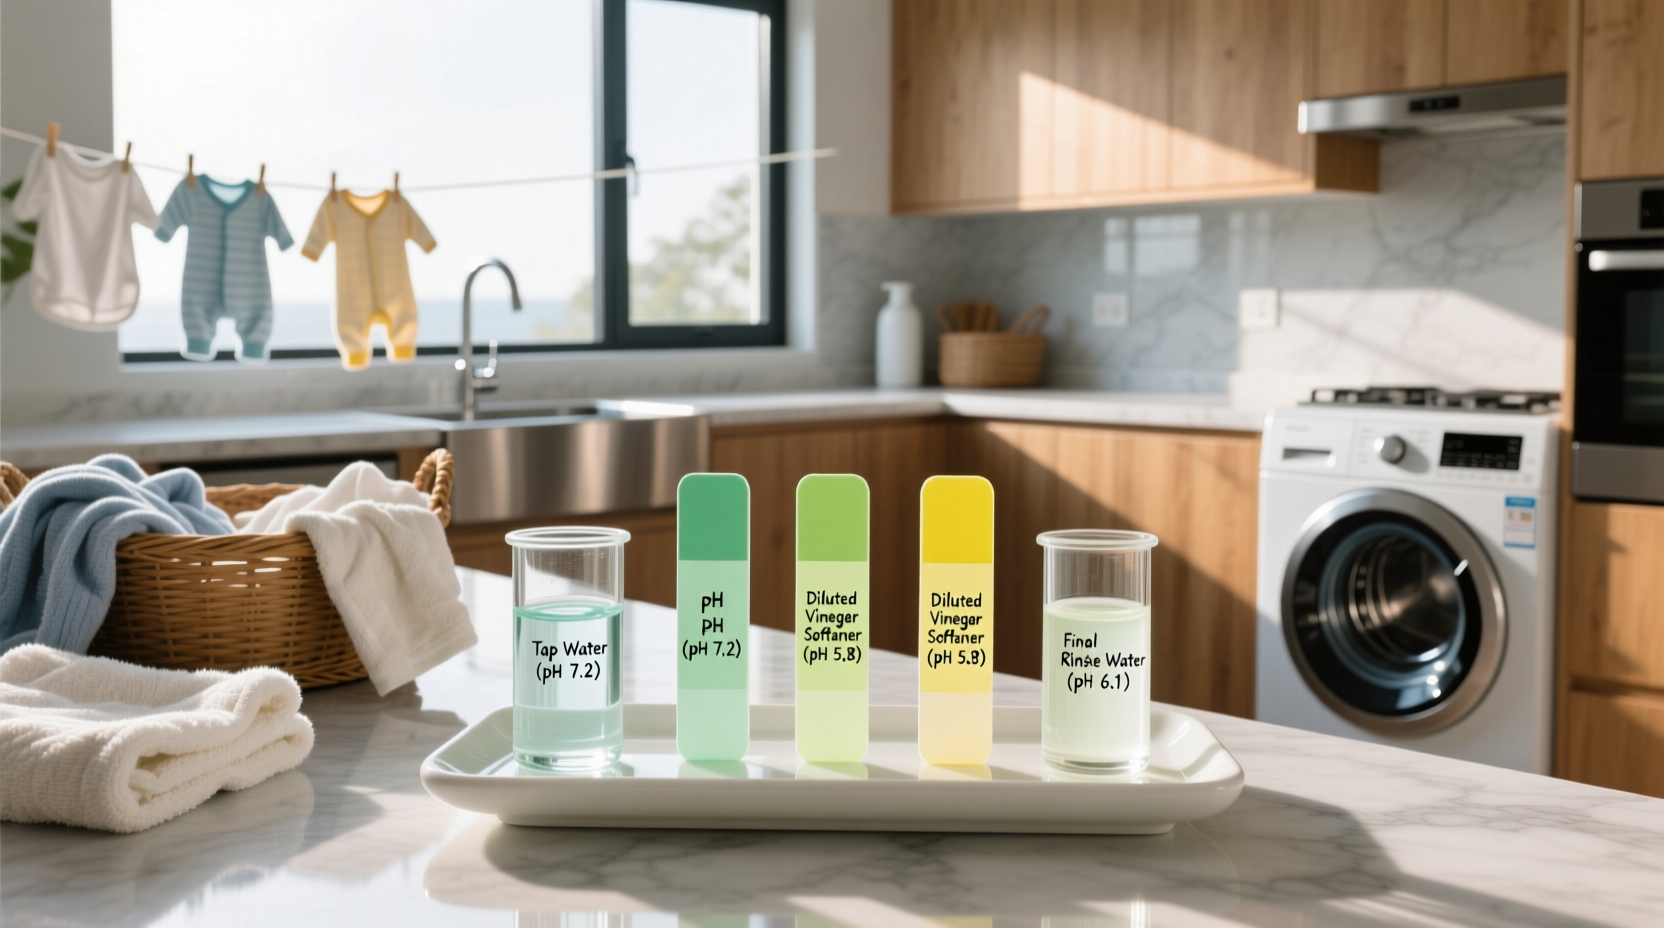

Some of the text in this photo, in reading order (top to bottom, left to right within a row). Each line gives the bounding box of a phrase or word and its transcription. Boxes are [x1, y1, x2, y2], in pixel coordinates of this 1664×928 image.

[701, 591, 724, 614] pH
[806, 590, 857, 606] Diluted
[931, 591, 982, 608] Diluted
[701, 616, 724, 637] pH
[531, 640, 608, 662] Tap Water
[681, 638, 742, 662] (pH 7.2)
[1064, 632, 1098, 649] Final
[803, 645, 863, 666] (pH 5.8)
[927, 648, 987, 670] (pH 5.8)
[1105, 652, 1147, 668] Water
[535, 661, 601, 685] (pH 7.2)
[1067, 671, 1131, 694] (pH 6.1)
